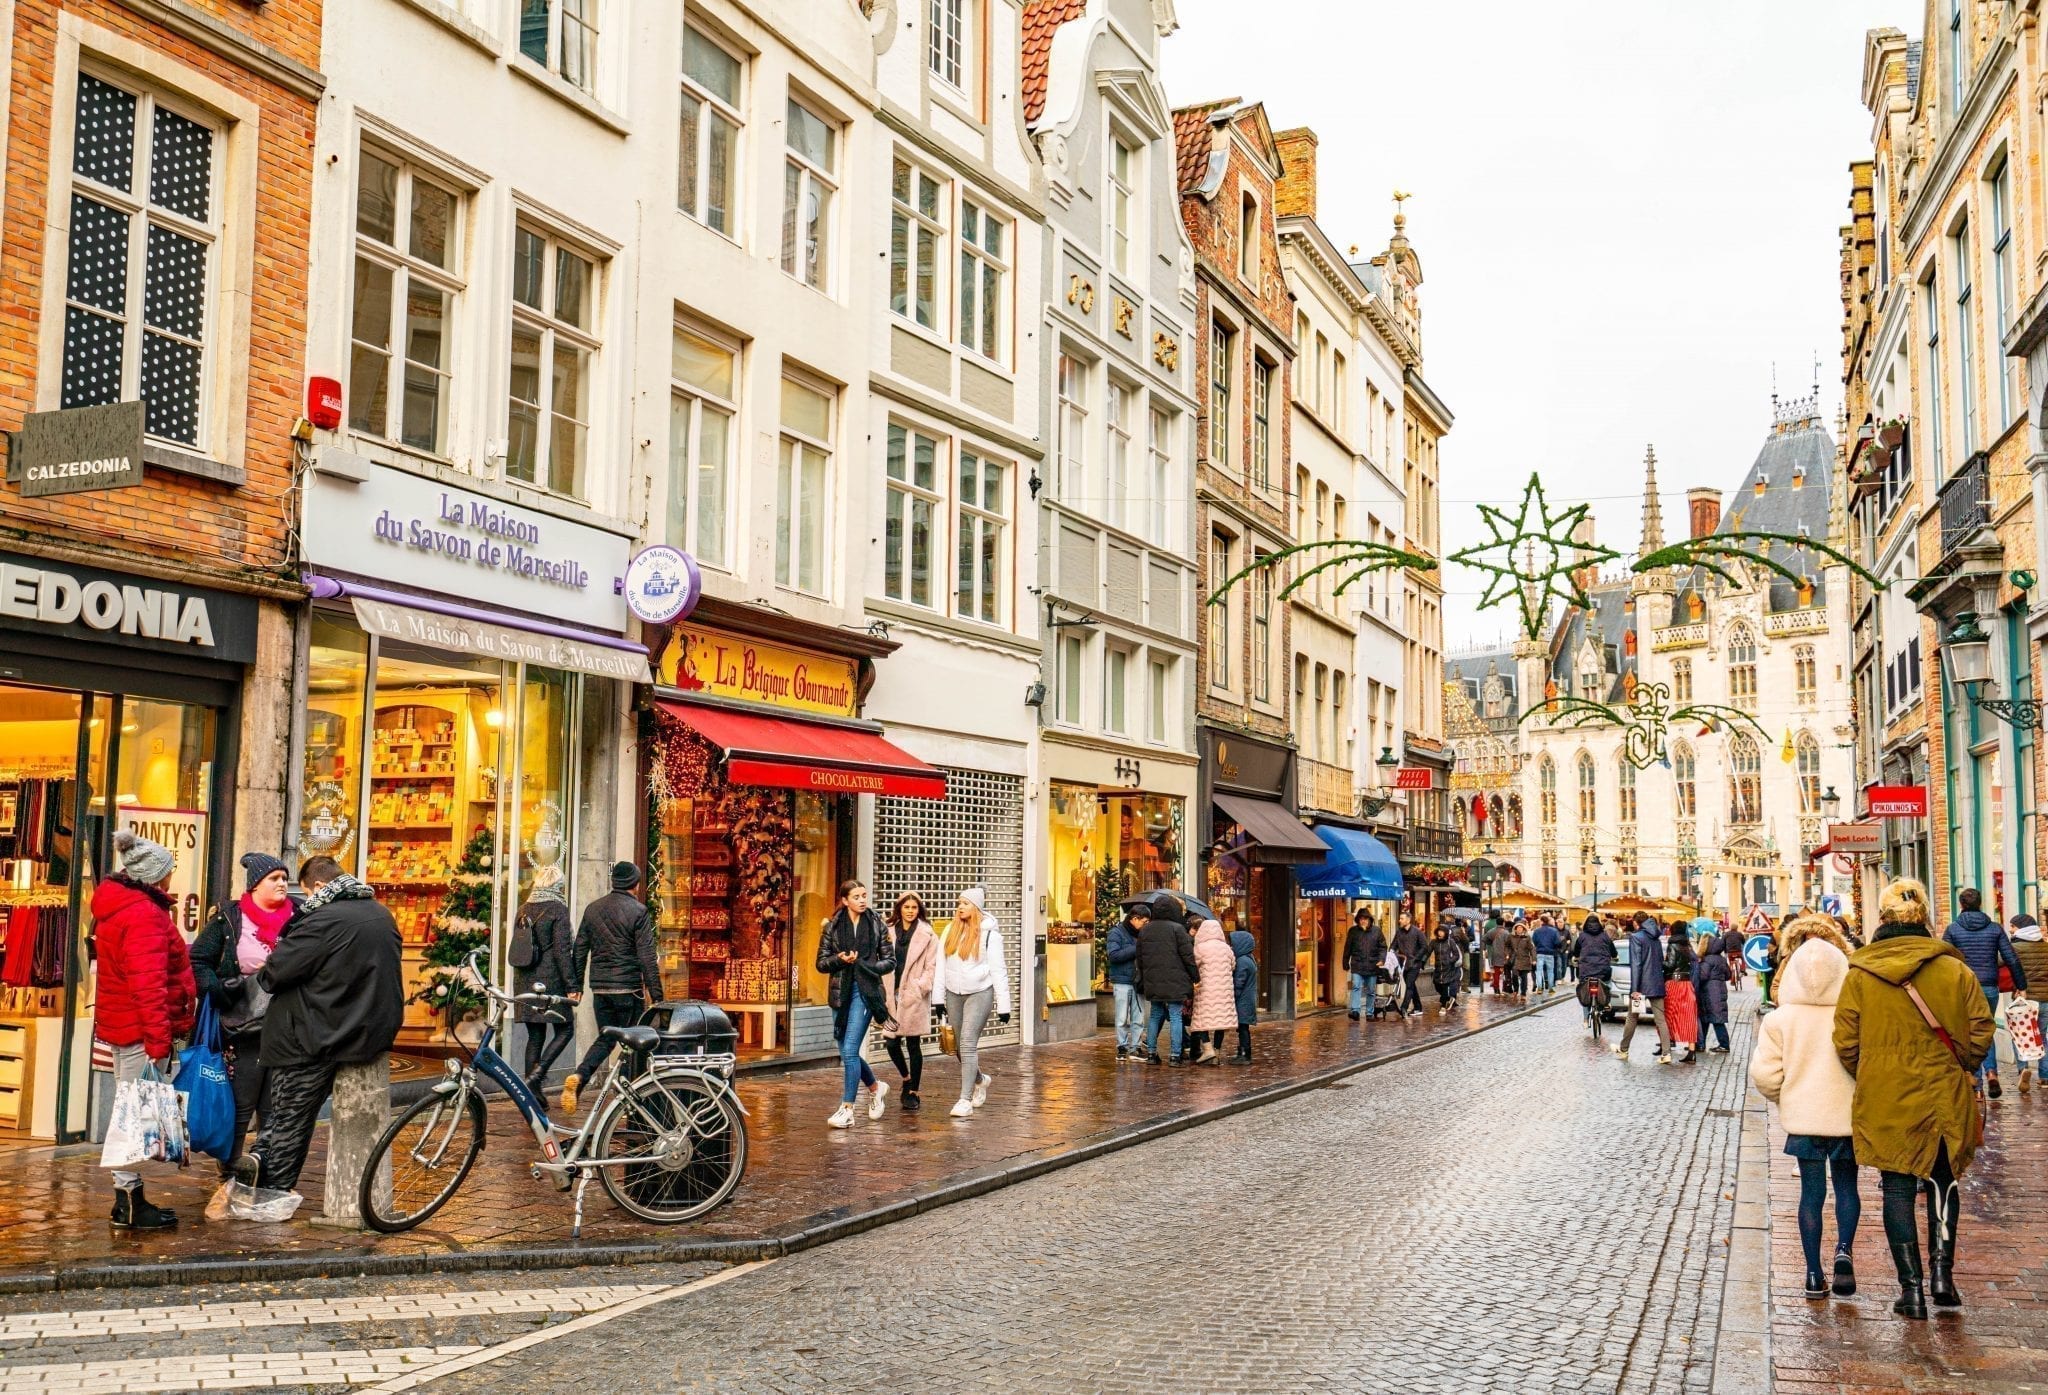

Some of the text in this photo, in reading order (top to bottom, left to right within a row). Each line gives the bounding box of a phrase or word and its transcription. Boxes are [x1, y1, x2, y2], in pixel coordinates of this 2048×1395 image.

[27, 456, 132, 481] CALZEDONIA
[440, 493, 539, 544] La Maison
[375, 510, 588, 588] du Savon de Marseille
[637, 550, 678, 566] La Maison
[628, 586, 688, 619] du Savon de Marseille
[377, 609, 639, 676] La Maison du Savon de Marseille
[713, 645, 849, 709] La Belgique Gourmande
[306, 781, 347, 800] La Maison
[810, 771, 885, 791] CHOCOLATERIE
[1874, 803, 1910, 812] PIKOLINOS
[1833, 835, 1879, 843] Foot Locker
[1301, 887, 1346, 897] Leonidas
